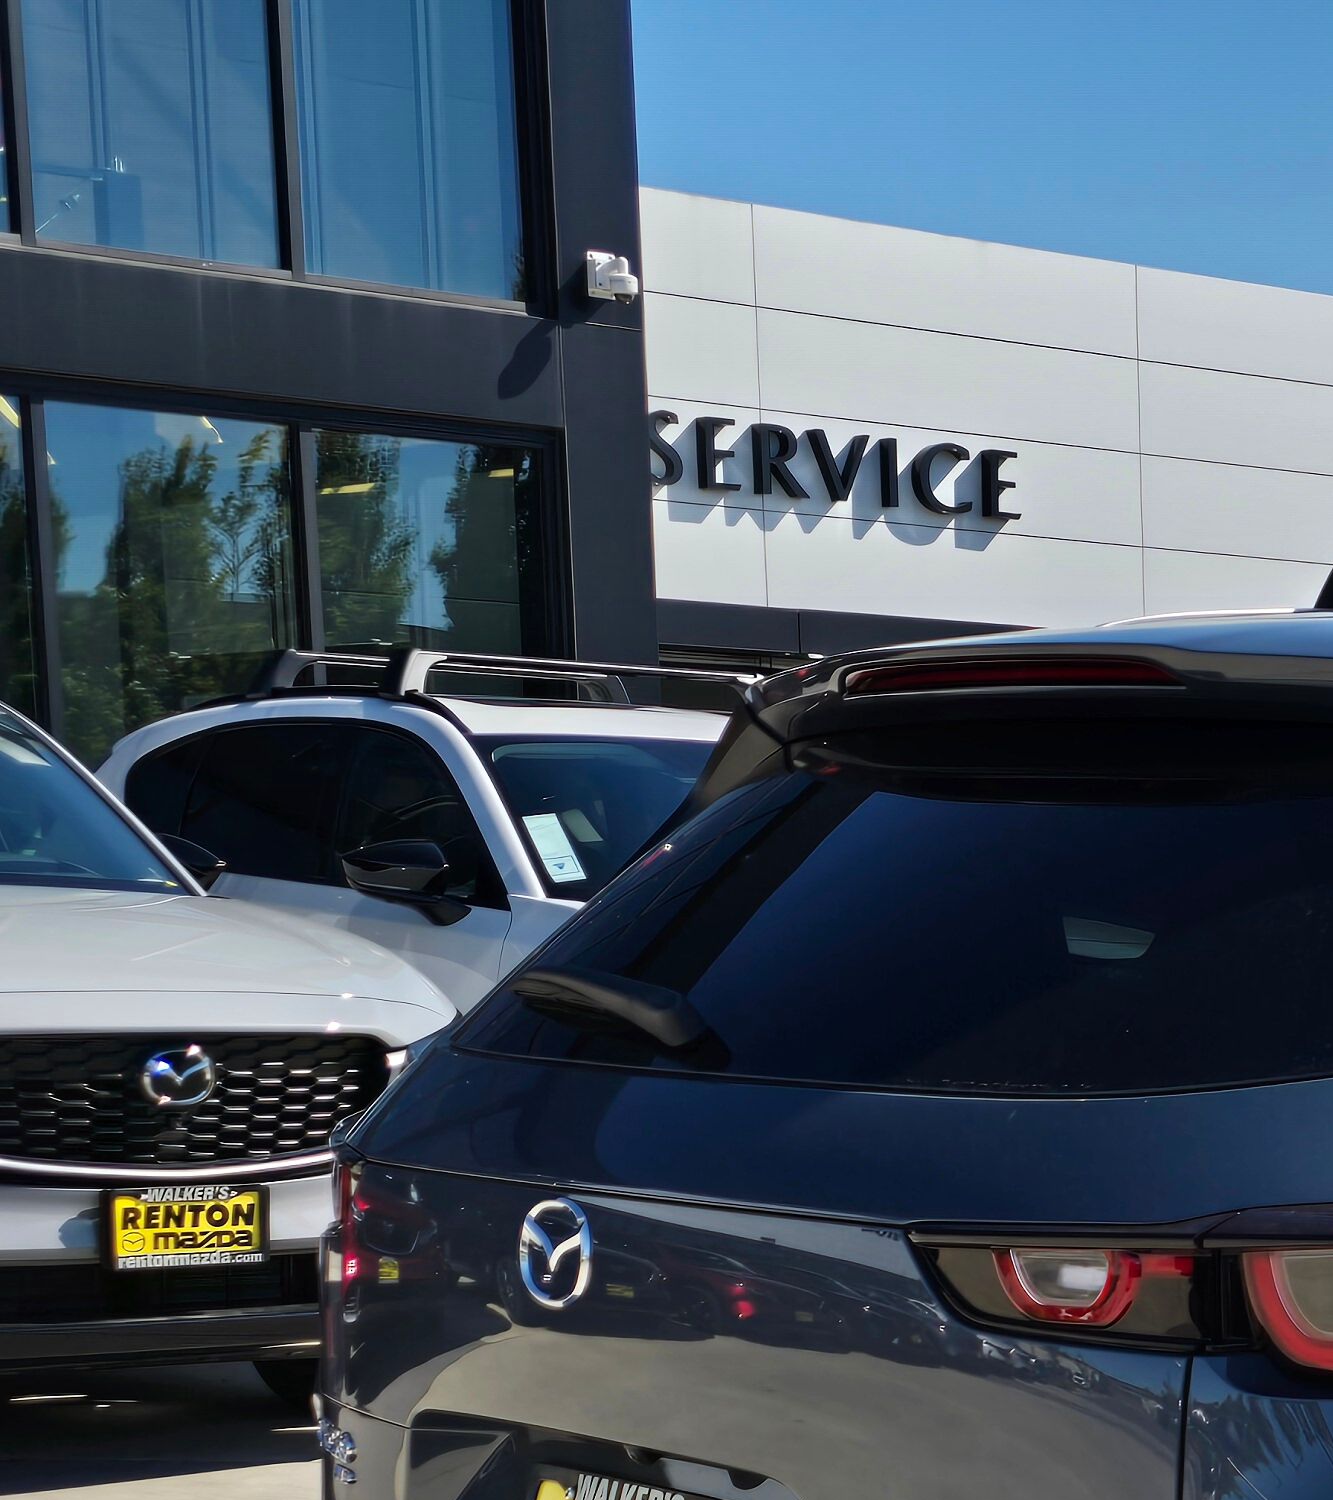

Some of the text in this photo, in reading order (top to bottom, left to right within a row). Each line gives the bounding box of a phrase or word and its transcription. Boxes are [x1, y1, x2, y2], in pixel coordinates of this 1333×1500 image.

[648, 409, 1022, 520] SERVICE
[147, 1185, 230, 1202] WALKER'S
[121, 1203, 255, 1230] RENTON
[117, 1250, 263, 1269] rentonmazda.com
